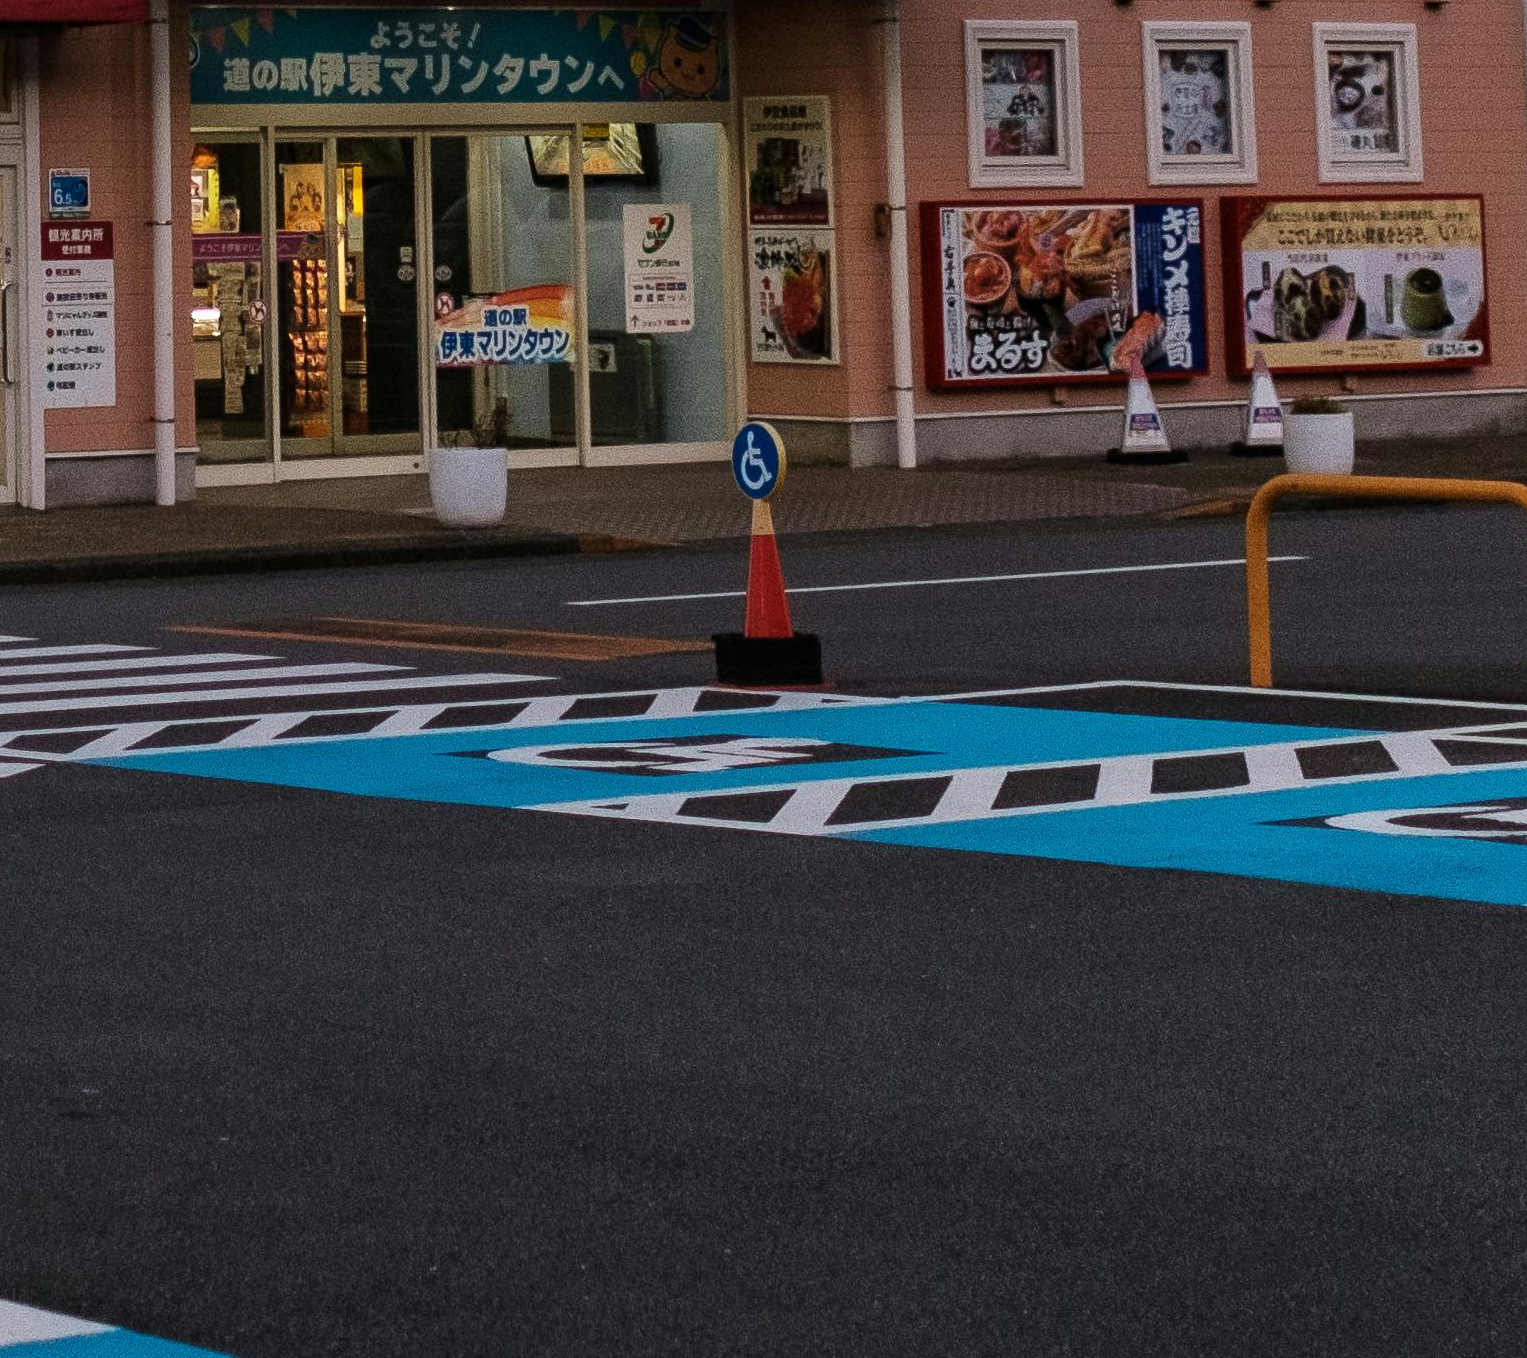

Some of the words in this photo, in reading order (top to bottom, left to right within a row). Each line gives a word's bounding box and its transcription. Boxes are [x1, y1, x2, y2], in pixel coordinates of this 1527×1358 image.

[48, 228, 104, 242] 観光案内所
[483, 307, 527, 328] 道の駅
[440, 328, 570, 360] 伊東マリンタウン
